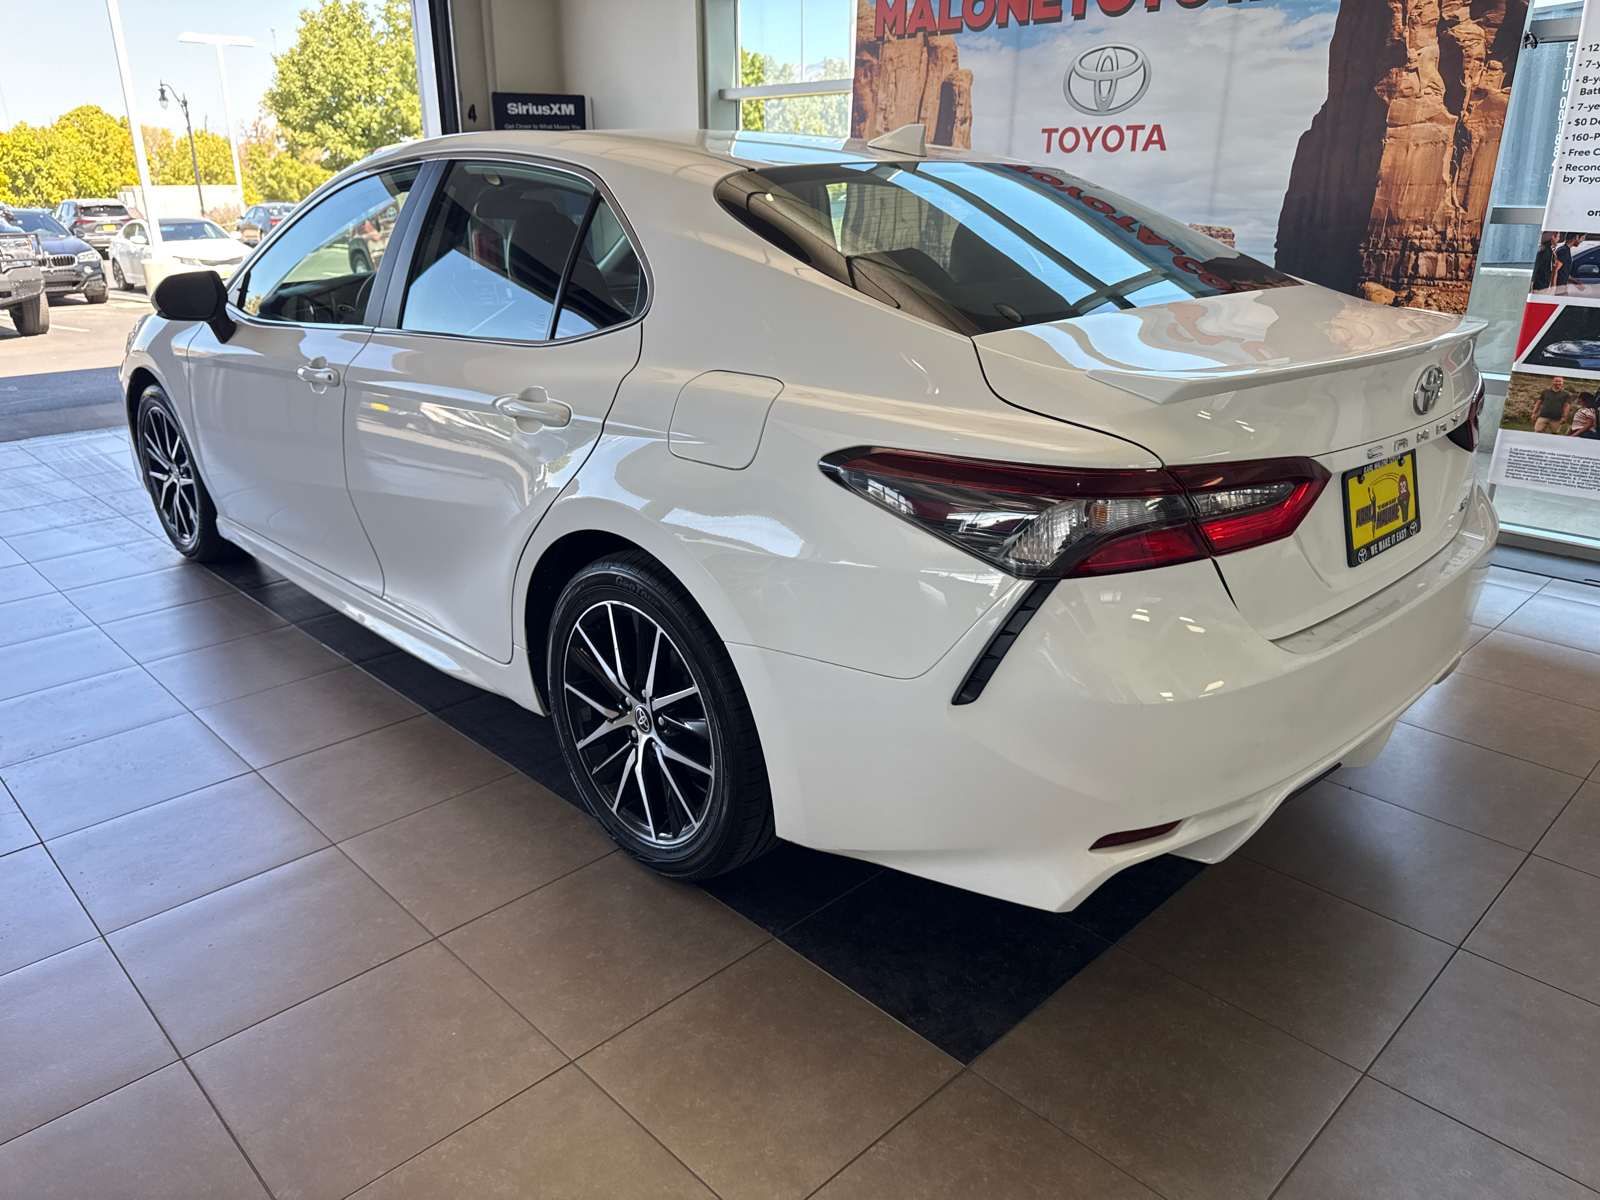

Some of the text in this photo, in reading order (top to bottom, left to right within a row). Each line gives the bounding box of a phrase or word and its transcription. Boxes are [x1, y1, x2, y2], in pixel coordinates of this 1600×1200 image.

[507, 102, 576, 116] SiriusXM
[1574, 117, 1588, 126] $0
[1041, 124, 1167, 154] TOYOTA
[1568, 148, 1590, 156] Free
[1563, 174, 1576, 185] by
[1366, 413, 1461, 460] CAMRY
[1400, 481, 1407, 494] 32
